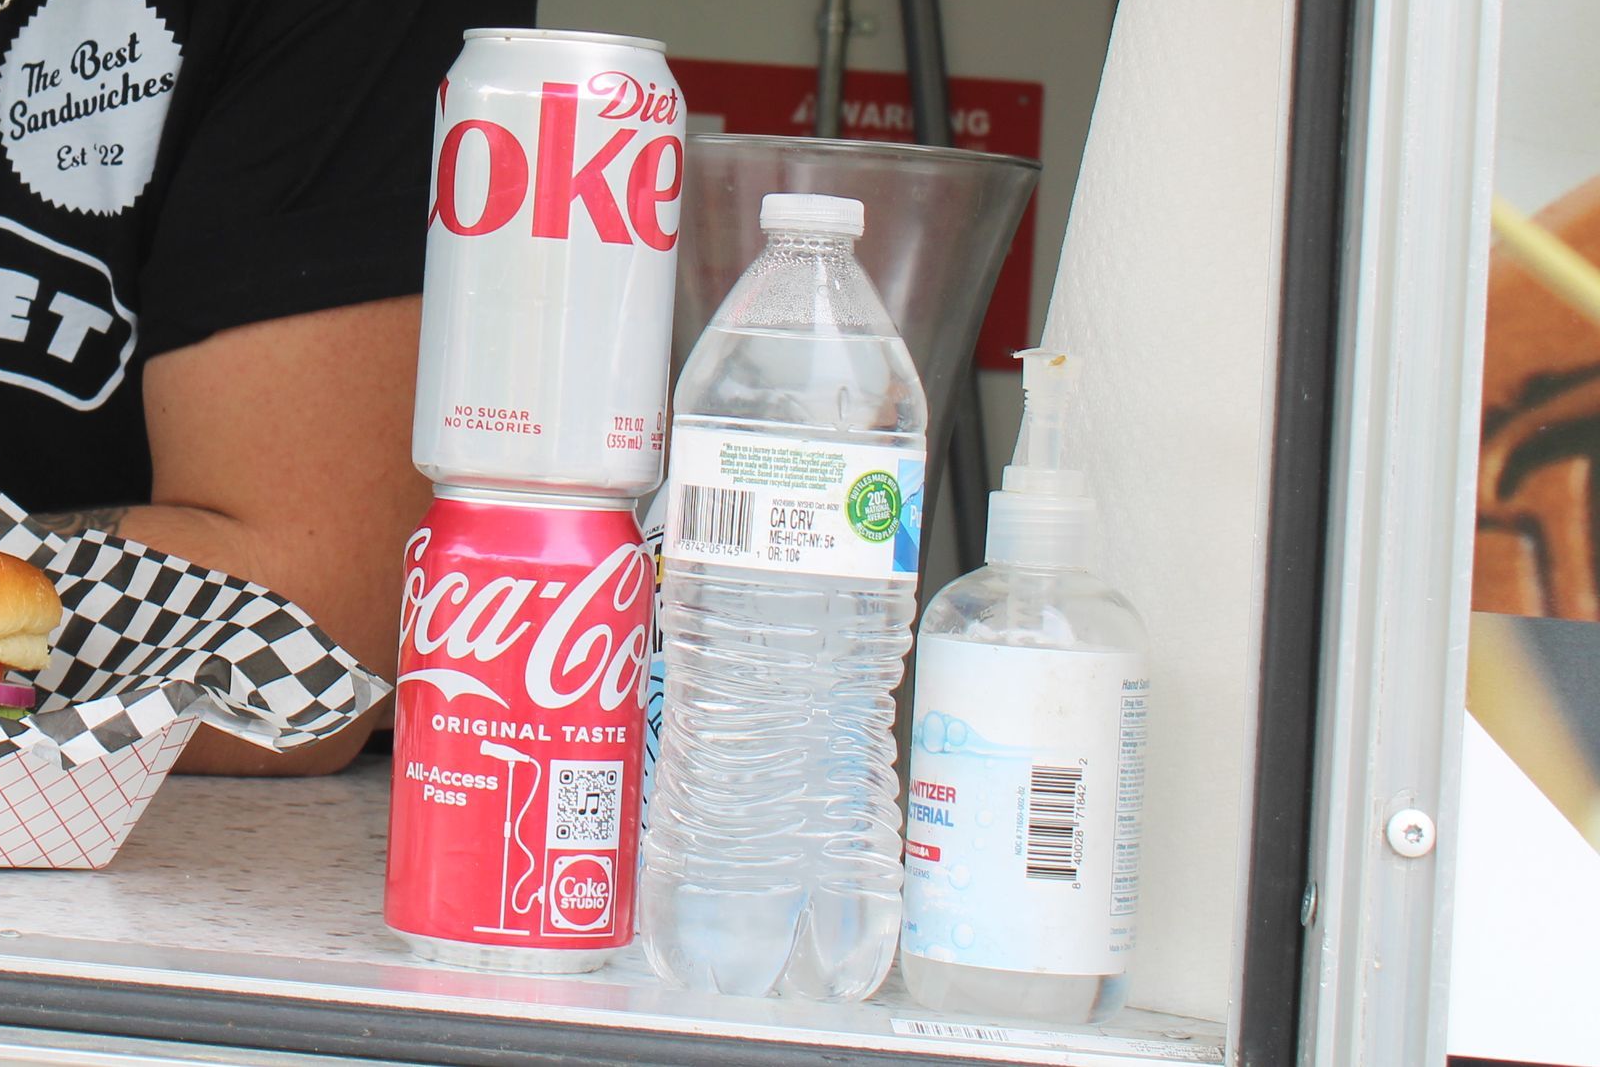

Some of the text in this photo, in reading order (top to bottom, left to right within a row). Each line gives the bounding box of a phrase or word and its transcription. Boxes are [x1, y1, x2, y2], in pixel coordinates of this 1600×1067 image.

[20, 32, 142, 98] The Best
[9, 72, 175, 141] Sandwiches
[587, 71, 679, 125] Diet
[840, 100, 992, 137] WARNG
[56, 145, 87, 171] Est
[428, 74, 684, 252] oke
[454, 405, 530, 421] NO SUGAR
[614, 416, 644, 432] 12 FL OZ
[444, 416, 542, 434] NO CALORIES
[606, 434, 627, 449] (355
[867, 490, 887, 506] 20%
[770, 507, 815, 530] CA CRV
[680, 540, 705, 553] 78742
[708, 543, 740, 556] 05145
[769, 530, 823, 548] ME-HI-CT-NY:
[768, 546, 782, 562] OR:
[431, 714, 626, 743] ORIGINAL TASTE
[405, 761, 499, 790] All-Access
[423, 784, 467, 806] Pass
[1072, 758, 1088, 890] 8 40028 71842 2
[560, 898, 605, 910] STUDIO
